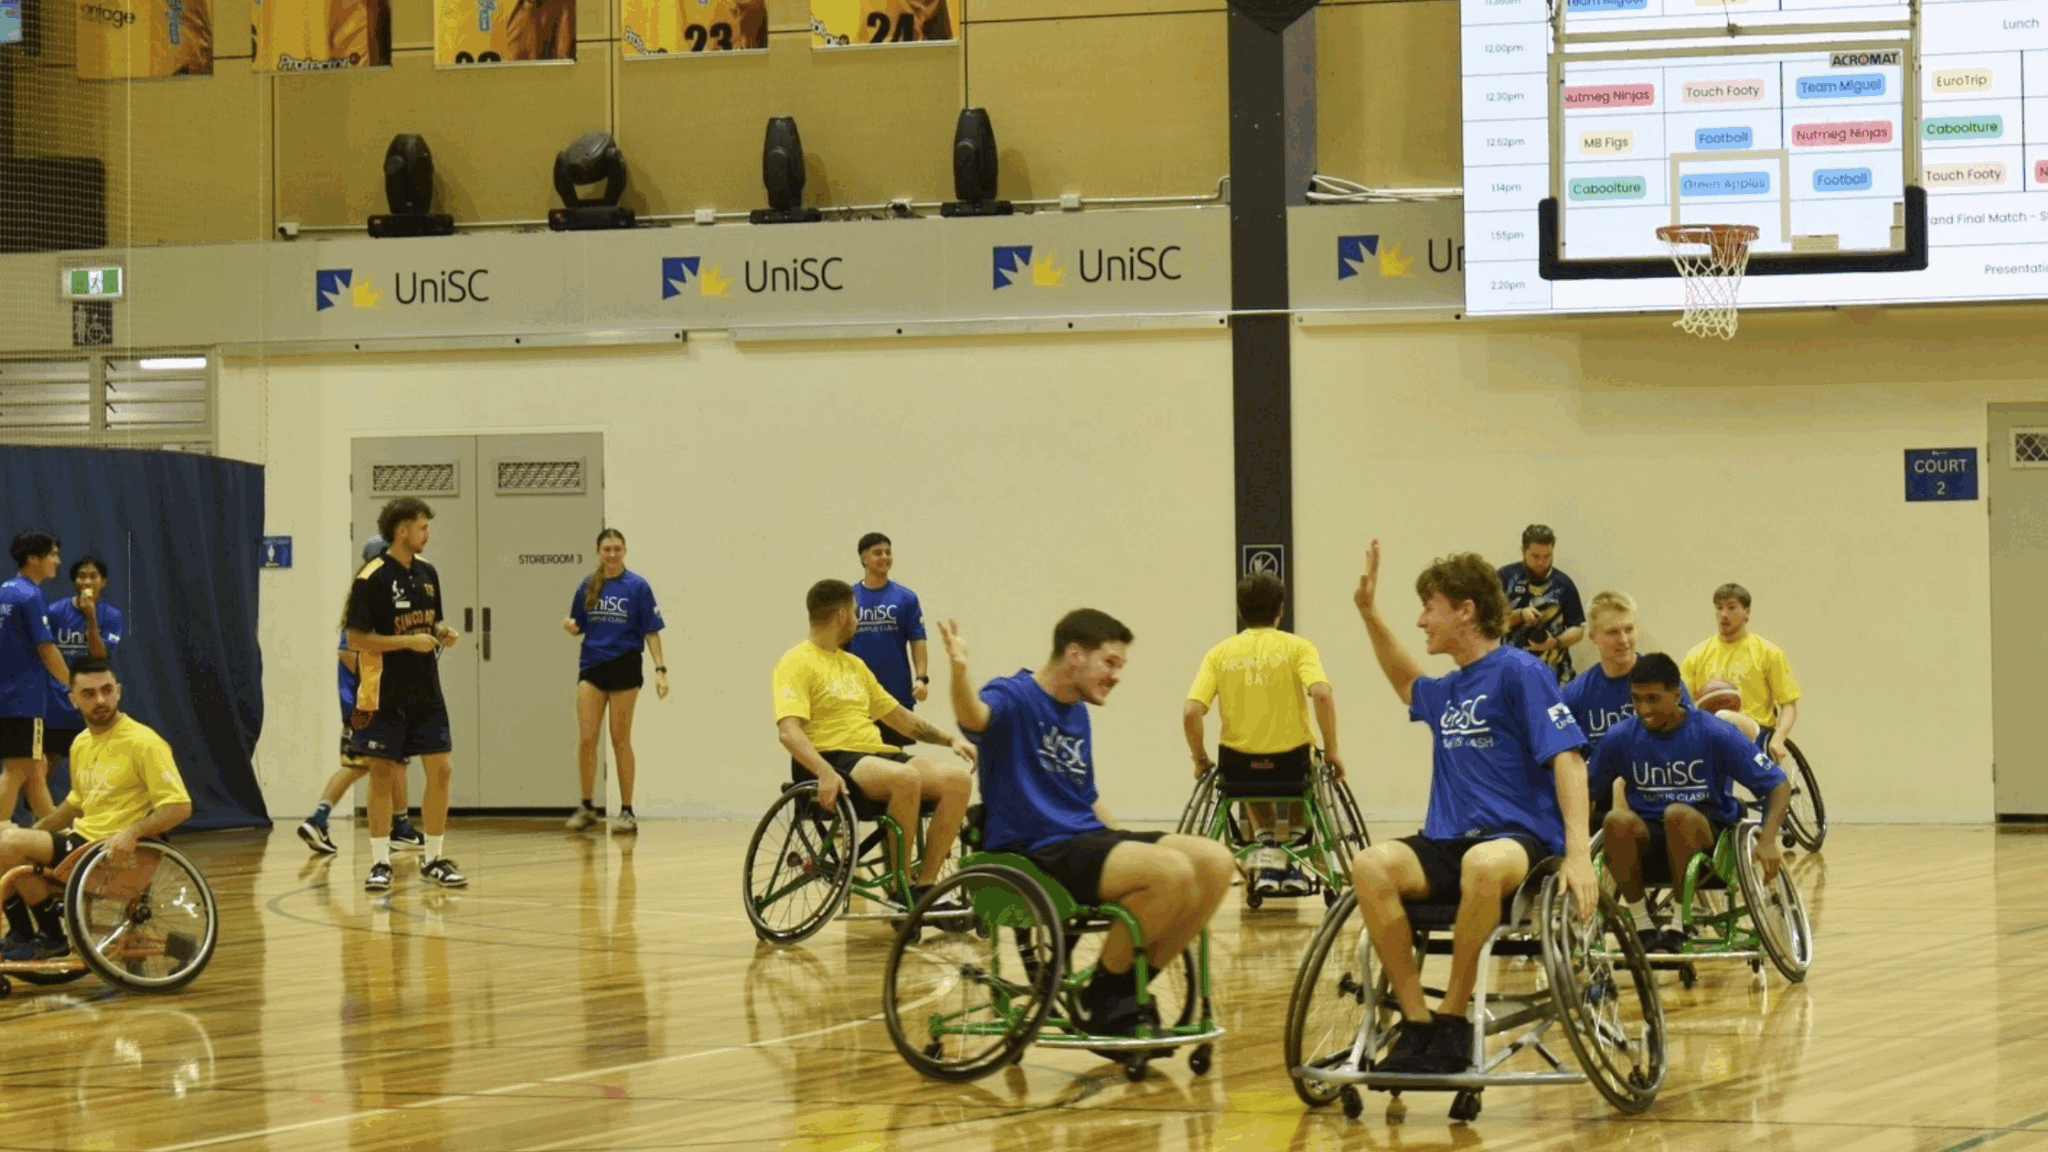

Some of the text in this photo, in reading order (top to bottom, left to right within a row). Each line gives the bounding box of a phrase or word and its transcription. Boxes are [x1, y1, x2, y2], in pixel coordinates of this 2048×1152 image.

[2003, 18, 2040, 30] Lunch
[684, 22, 733, 52] 23
[1832, 53, 1899, 67] ACROMAT
[1800, 78, 1882, 95] Team Miguel
[1936, 73, 1988, 88] EuroTrip
[1613, 90, 1650, 103] Ninjas
[1686, 83, 1760, 99] Touch Footy
[1796, 127, 1888, 142] Nutmeg Ninjas
[1926, 121, 1998, 136] Caboolture
[1584, 136, 1629, 151] MB Figs
[1698, 131, 1749, 145] Football
[1817, 171, 1868, 186] Football
[1926, 168, 2002, 181] Touch Footy
[1573, 181, 1642, 195] Caboolture
[1957, 213, 1986, 223] Final
[1988, 211, 2028, 223] Match
[1078, 246, 1182, 283] UniSC
[745, 257, 845, 293] UniSC
[395, 269, 490, 305] UniSC
[1914, 459, 1967, 473] COURT
[1936, 480, 1946, 495] 2
[518, 554, 583, 565] STOREROOM 3
[594, 596, 629, 612] niSC
[1632, 758, 1707, 786] UniSC
